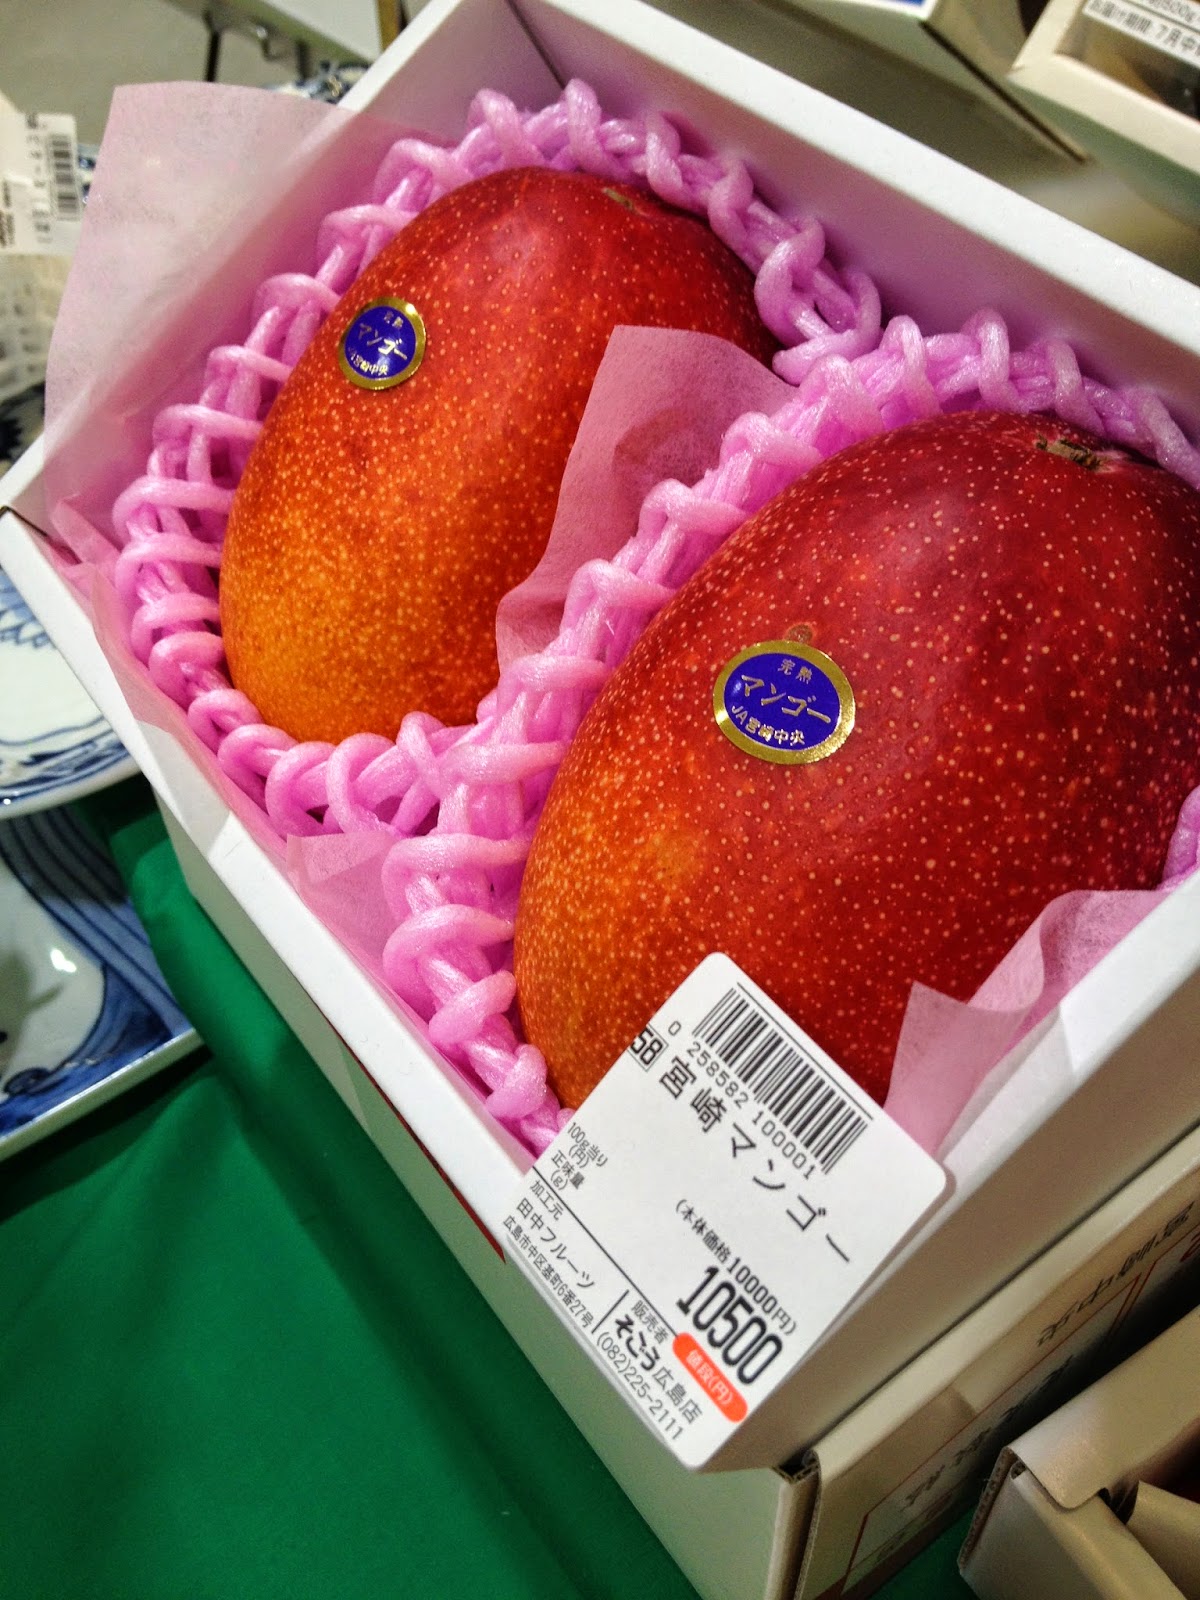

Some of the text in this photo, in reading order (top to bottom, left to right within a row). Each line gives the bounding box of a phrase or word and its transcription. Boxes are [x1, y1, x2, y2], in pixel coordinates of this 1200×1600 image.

[358, 323, 408, 361] マンゴー
[777, 658, 813, 685] 完熟
[741, 674, 832, 724] マンゴー
[731, 703, 806, 747] JA宮崎中央
[686, 1041, 749, 1109] 258582
[751, 1110, 817, 1180] 100001
[551, 1149, 586, 1190] 正味量
[530, 1179, 565, 1221] 加工元
[516, 1197, 595, 1289] 田中フルーツ
[631, 1300, 669, 1345] 販売者
[676, 1266, 783, 1385] 10500
[596, 1331, 684, 1441] (082)225-2111
